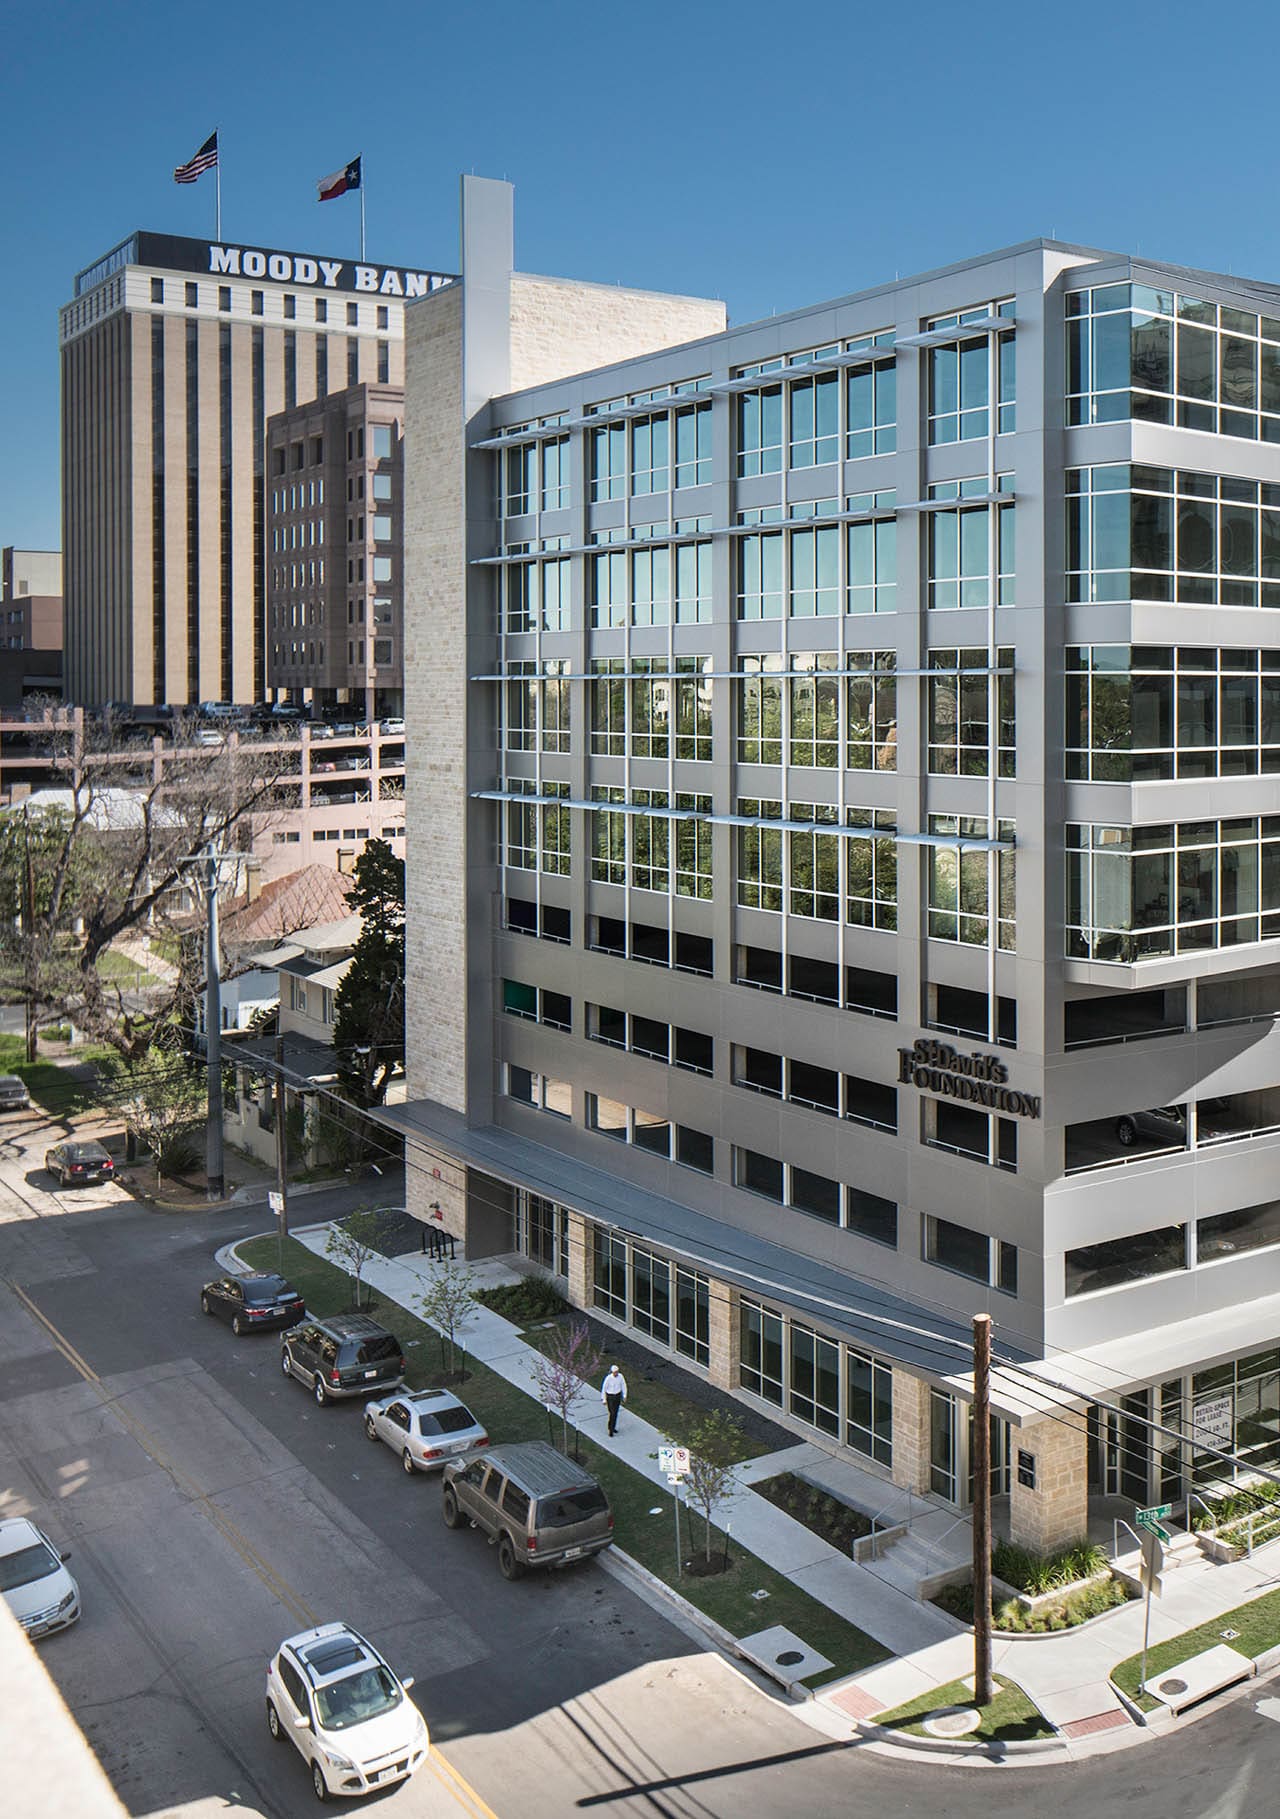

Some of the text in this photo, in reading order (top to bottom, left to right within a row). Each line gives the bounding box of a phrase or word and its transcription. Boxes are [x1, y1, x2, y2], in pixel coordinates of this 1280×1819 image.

[209, 245, 343, 287] MOODY
[897, 1048, 1041, 1119] FOUNDATION
[937, 1045, 1008, 1084] David's
[1195, 1410, 1223, 1425] FOR LEASE
